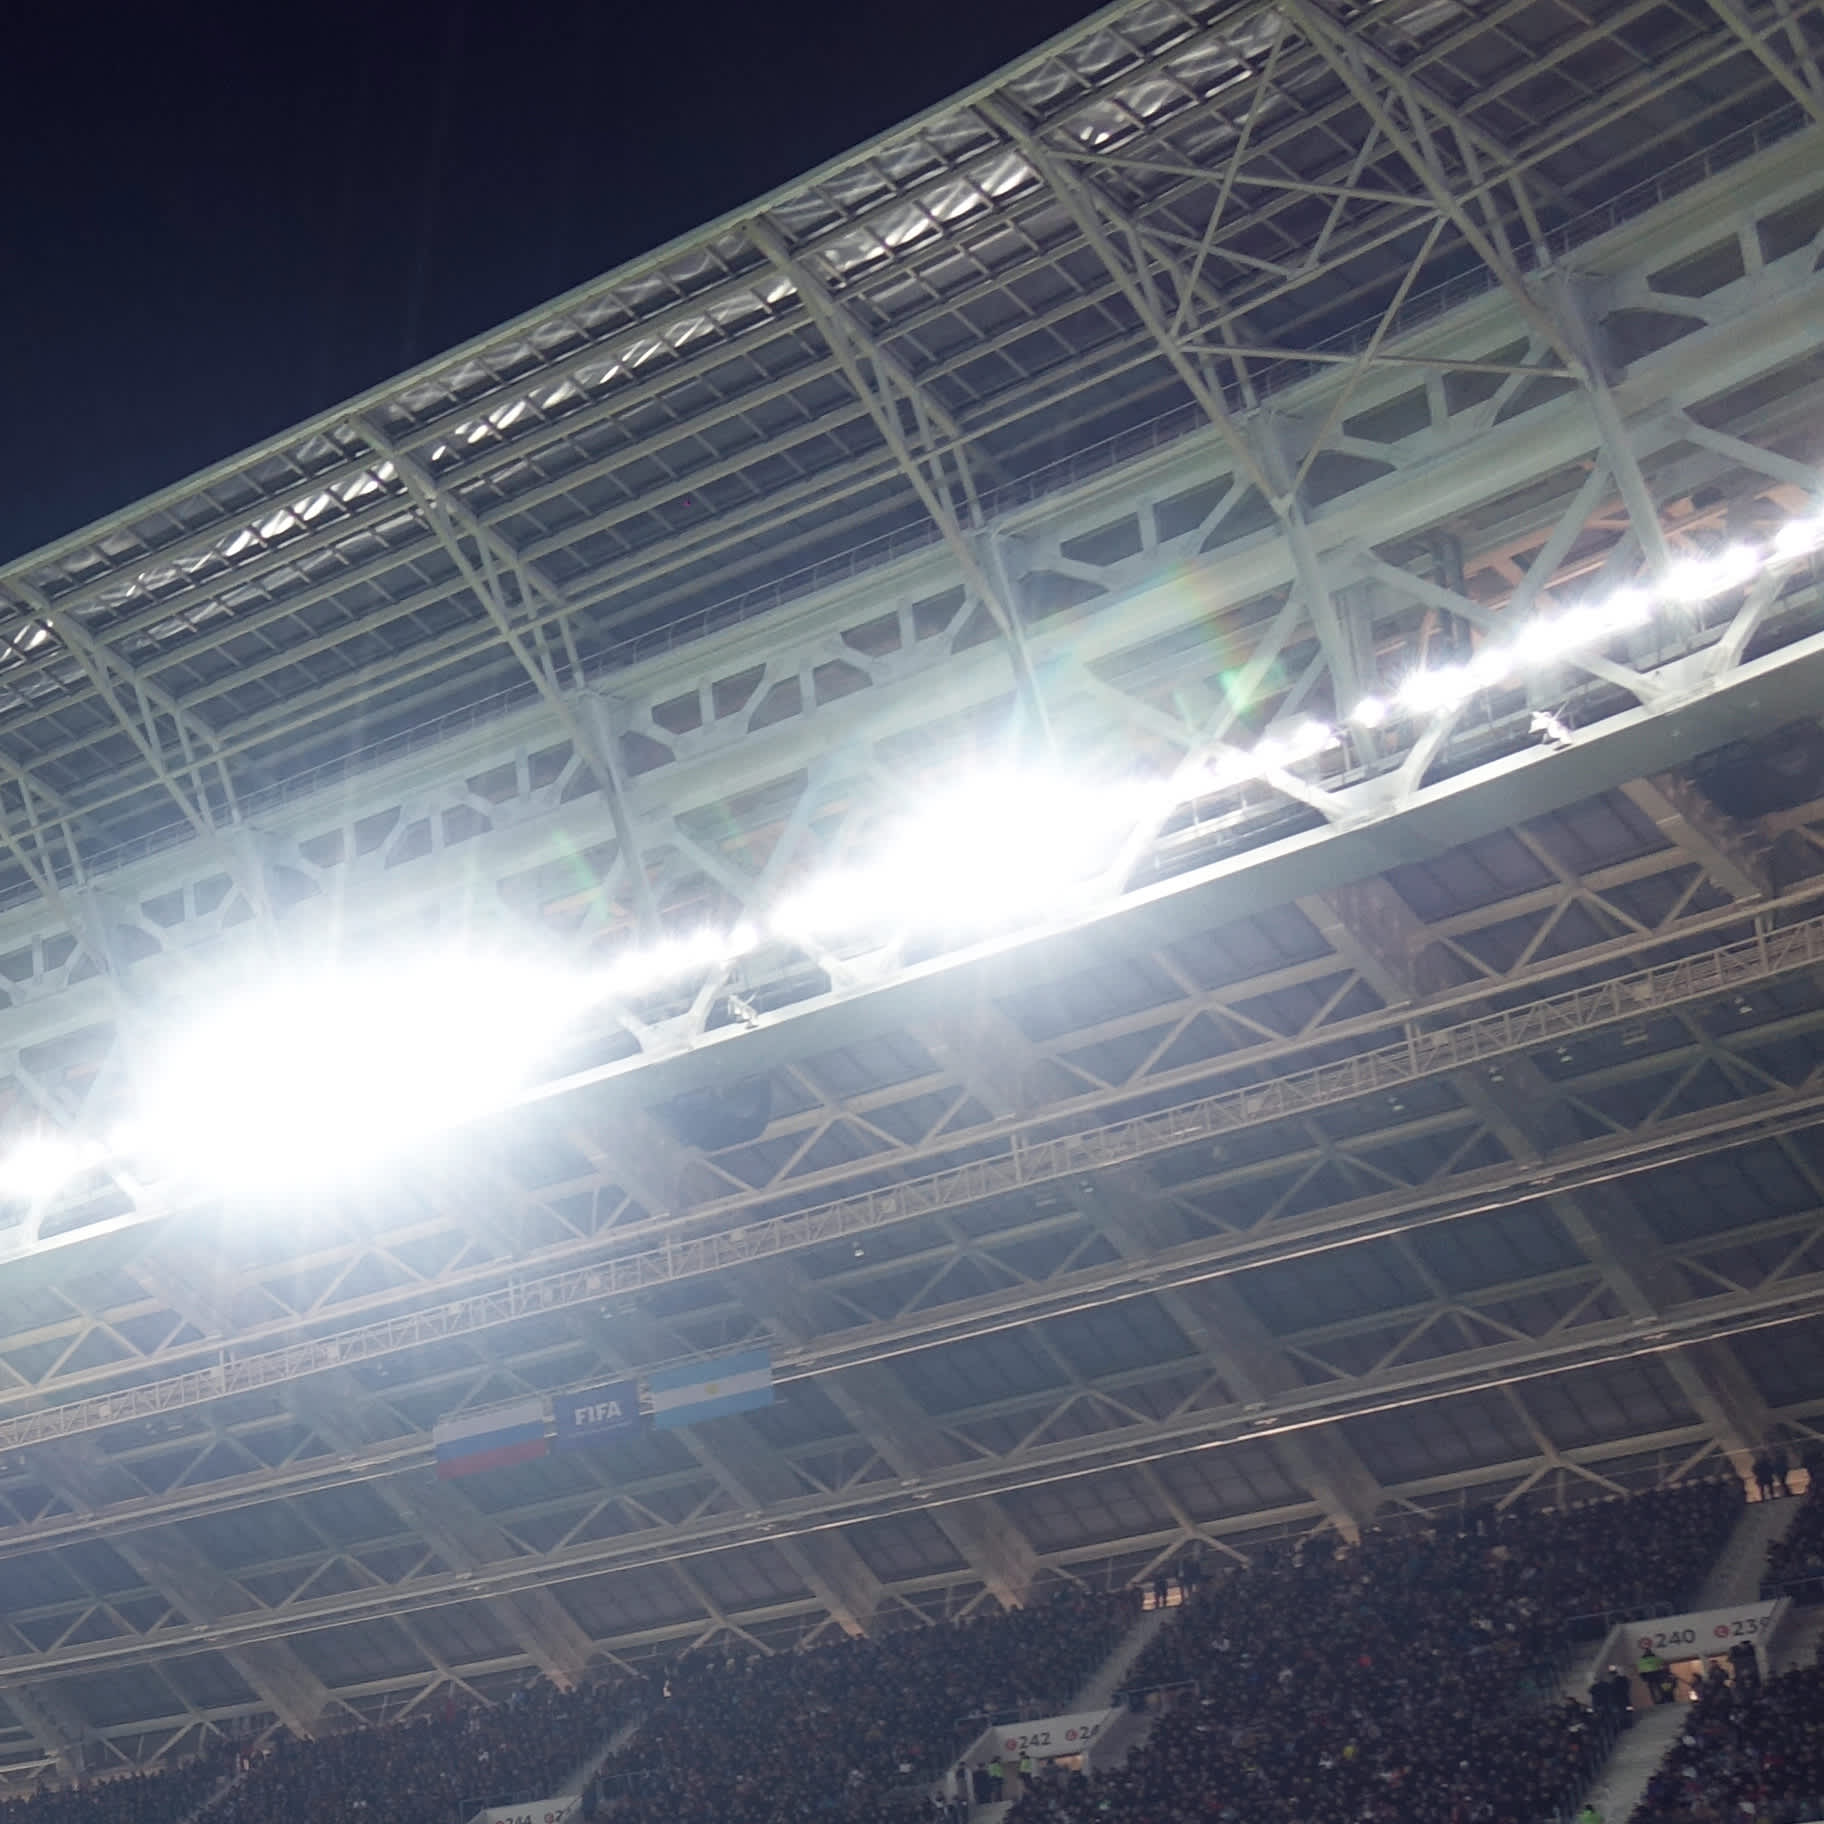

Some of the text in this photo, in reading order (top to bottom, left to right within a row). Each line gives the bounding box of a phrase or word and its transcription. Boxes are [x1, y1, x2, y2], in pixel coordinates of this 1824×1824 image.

[575, 1401, 622, 1426] FIFA
[1654, 1629, 1696, 1649] 240
[1018, 1732, 1052, 1749] 242
